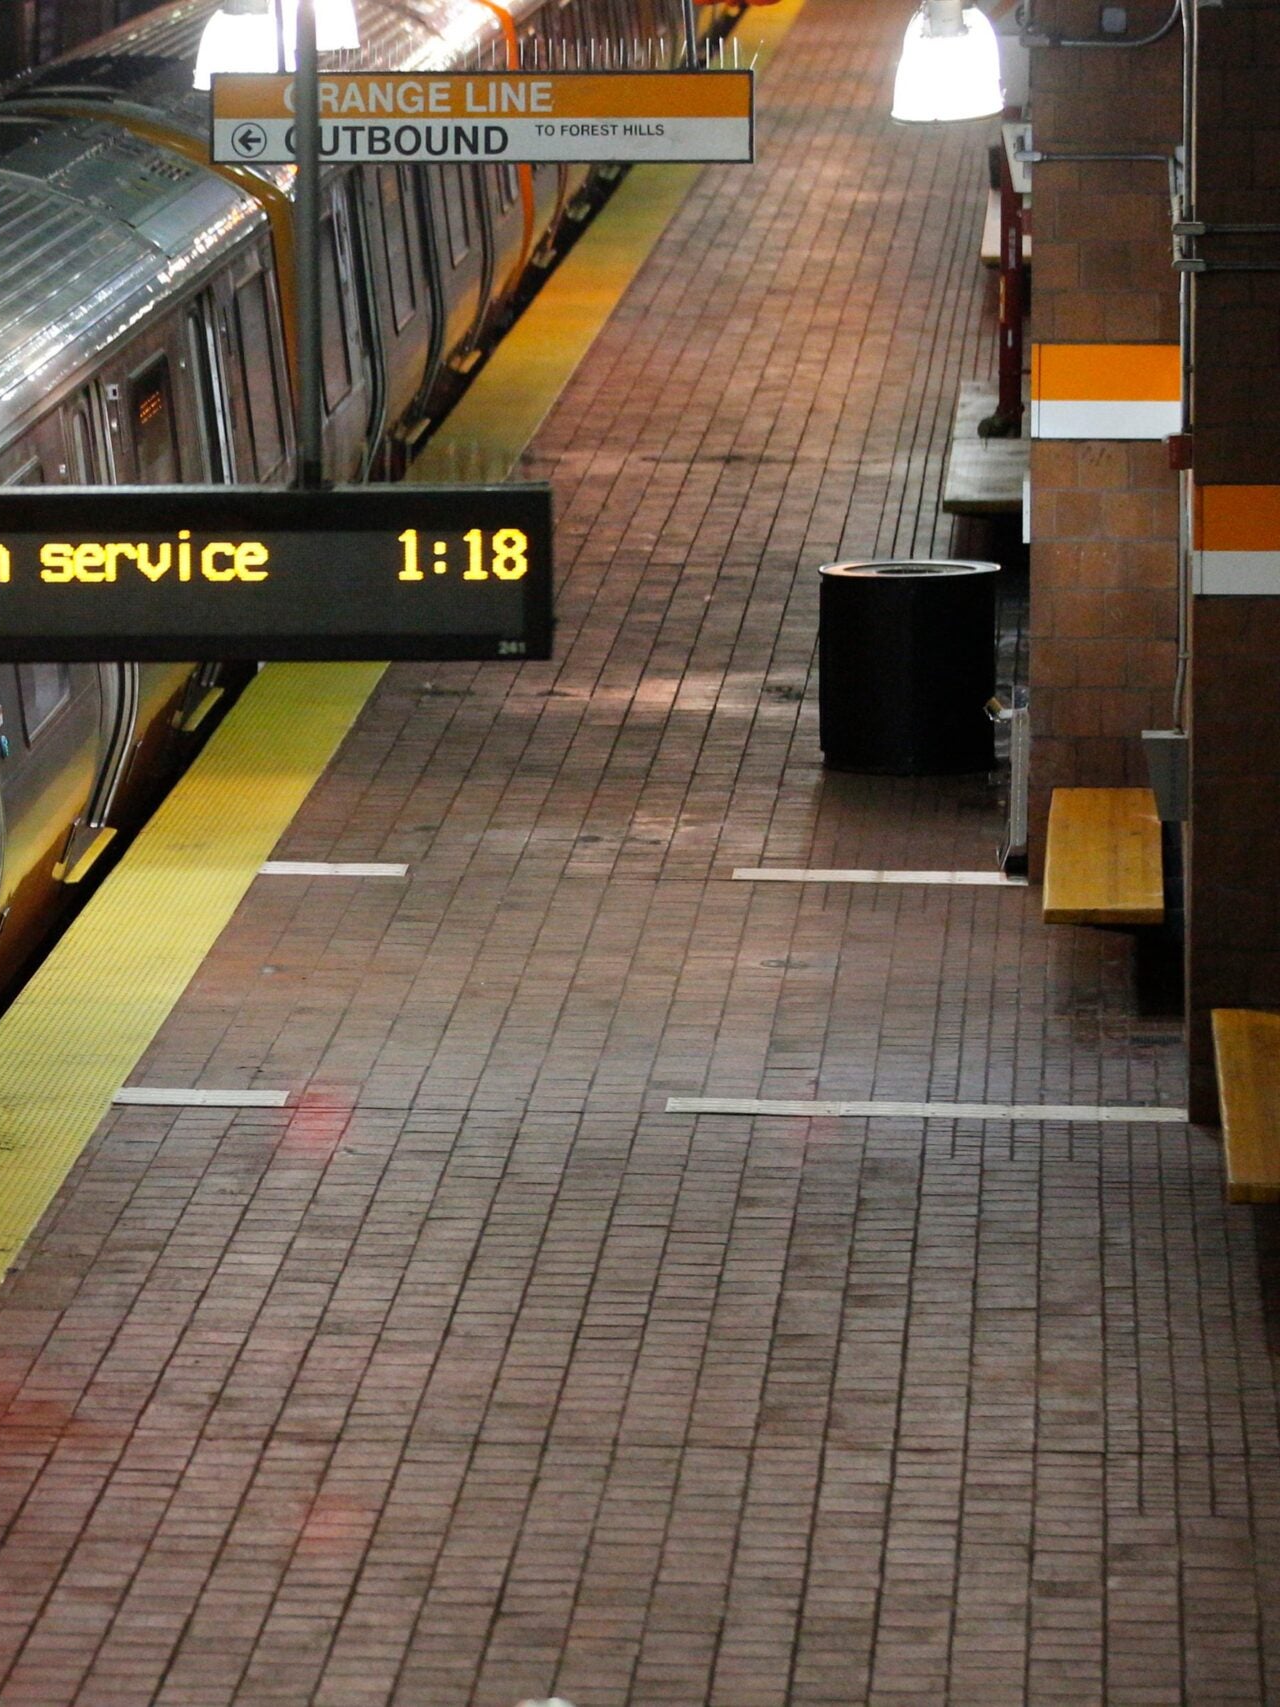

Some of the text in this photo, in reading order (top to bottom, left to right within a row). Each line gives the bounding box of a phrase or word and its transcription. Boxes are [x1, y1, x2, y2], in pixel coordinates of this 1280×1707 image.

[465, 81, 553, 113] LINE
[535, 124, 665, 136] TO FOREST HILLS
[40, 530, 269, 582] service
[398, 528, 528, 581] 1:18
